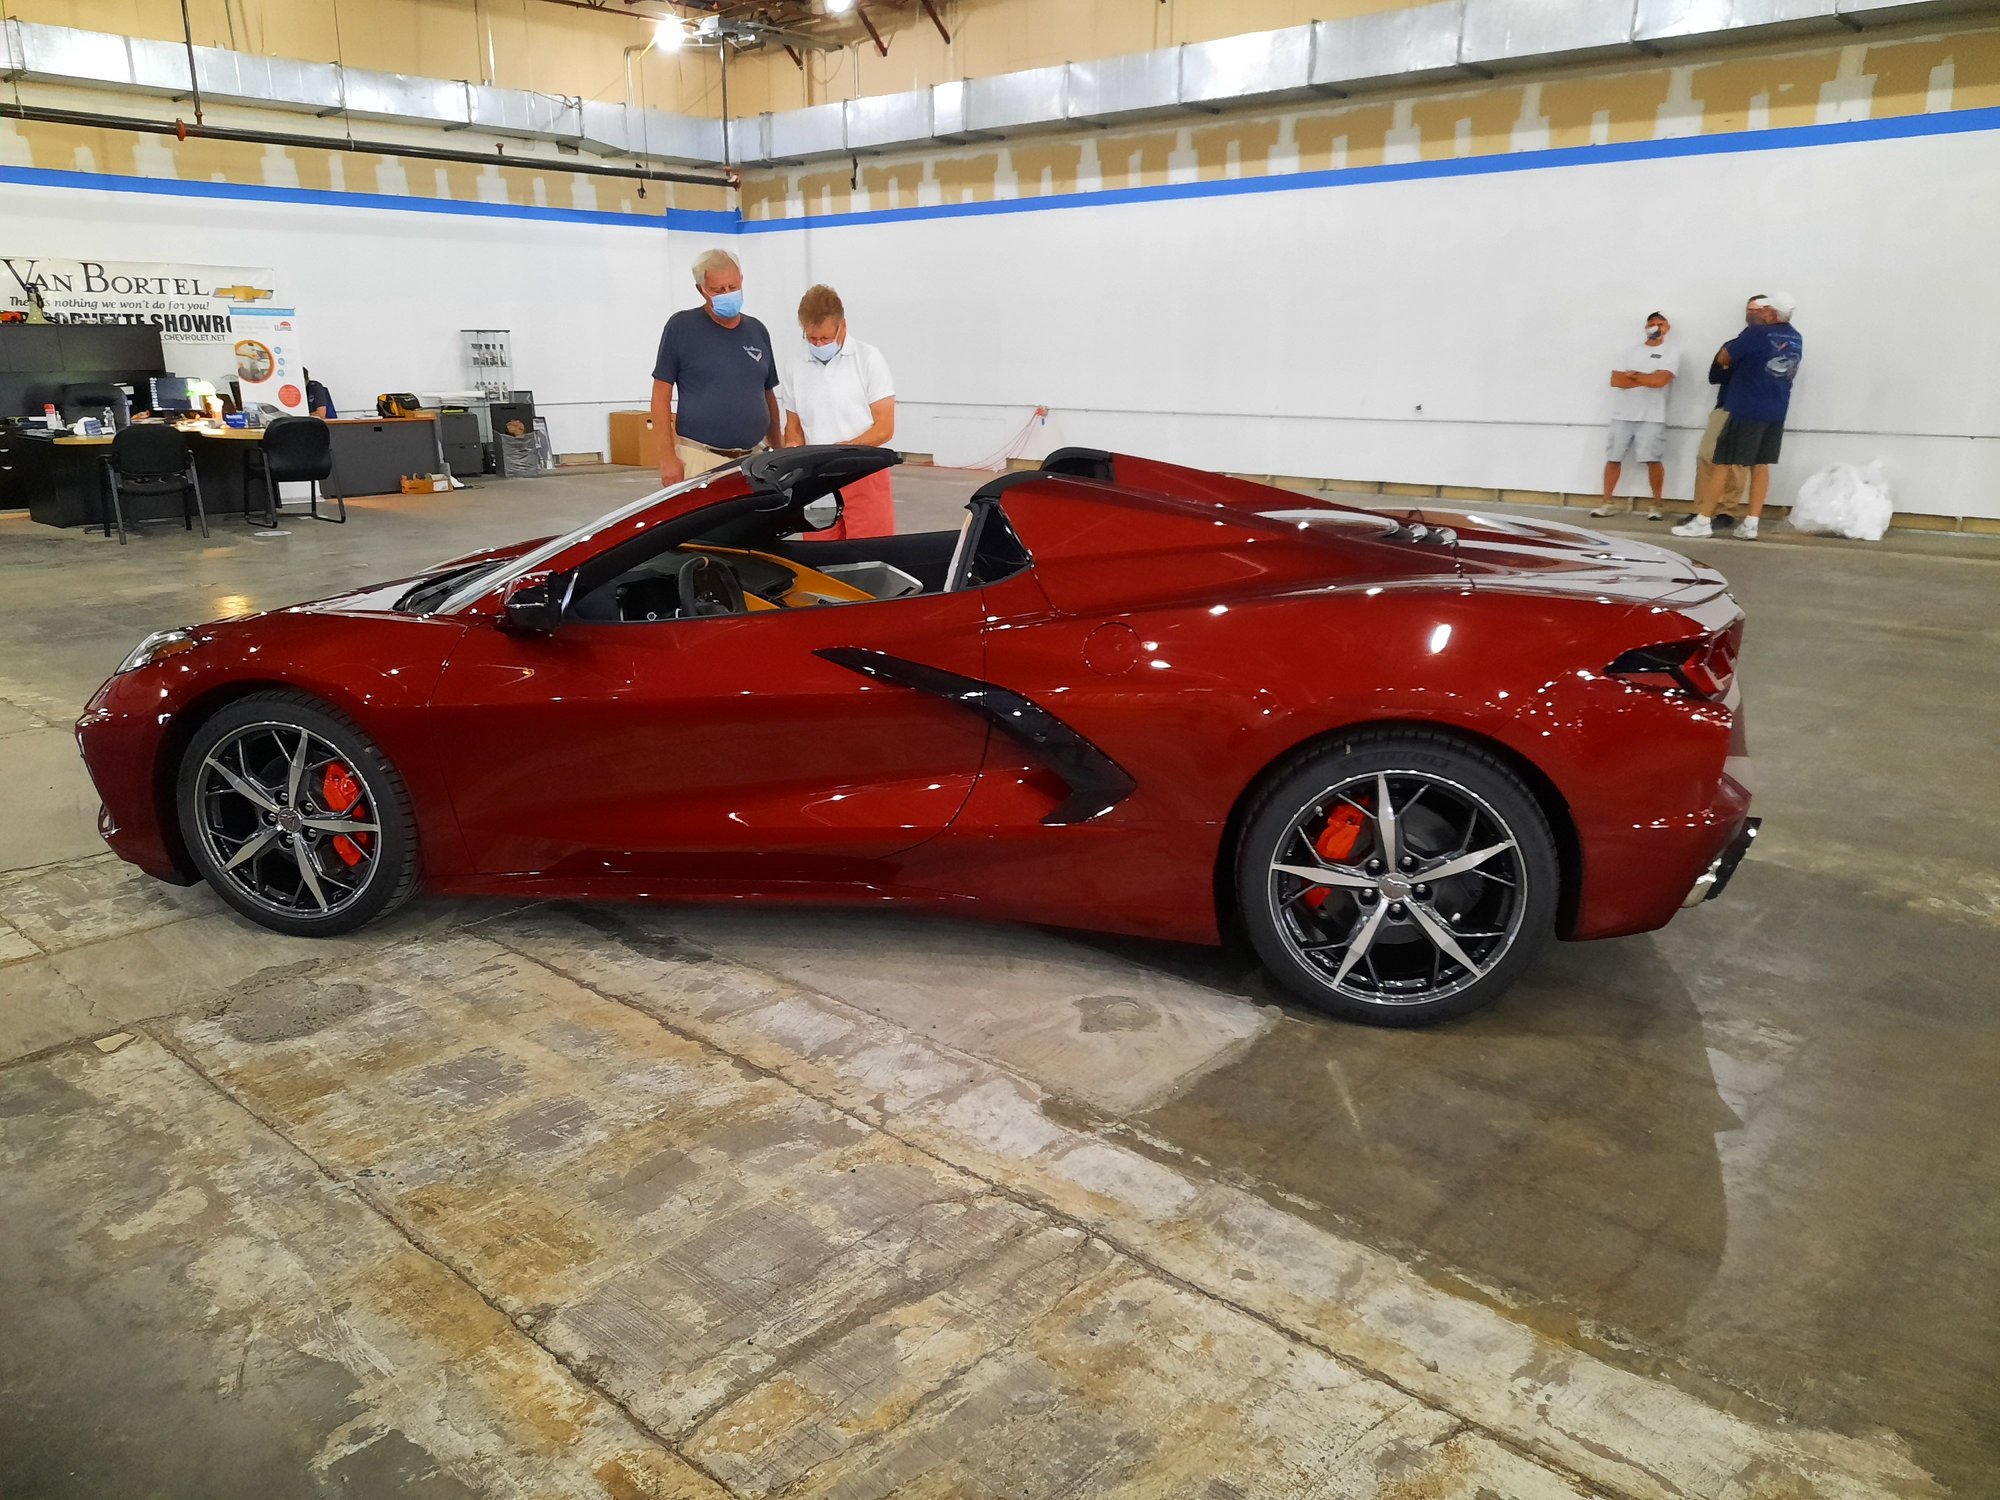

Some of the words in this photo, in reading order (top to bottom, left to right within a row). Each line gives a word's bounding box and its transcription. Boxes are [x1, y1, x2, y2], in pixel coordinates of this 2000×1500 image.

[0, 258, 73, 293] VAN
[78, 262, 209, 296] BORTEL
[54, 298, 98, 310] nothing
[102, 301, 117, 309] we
[120, 300, 150, 309] won't
[152, 300, 166, 309] do
[168, 301, 185, 311] for
[187, 301, 210, 311] you!
